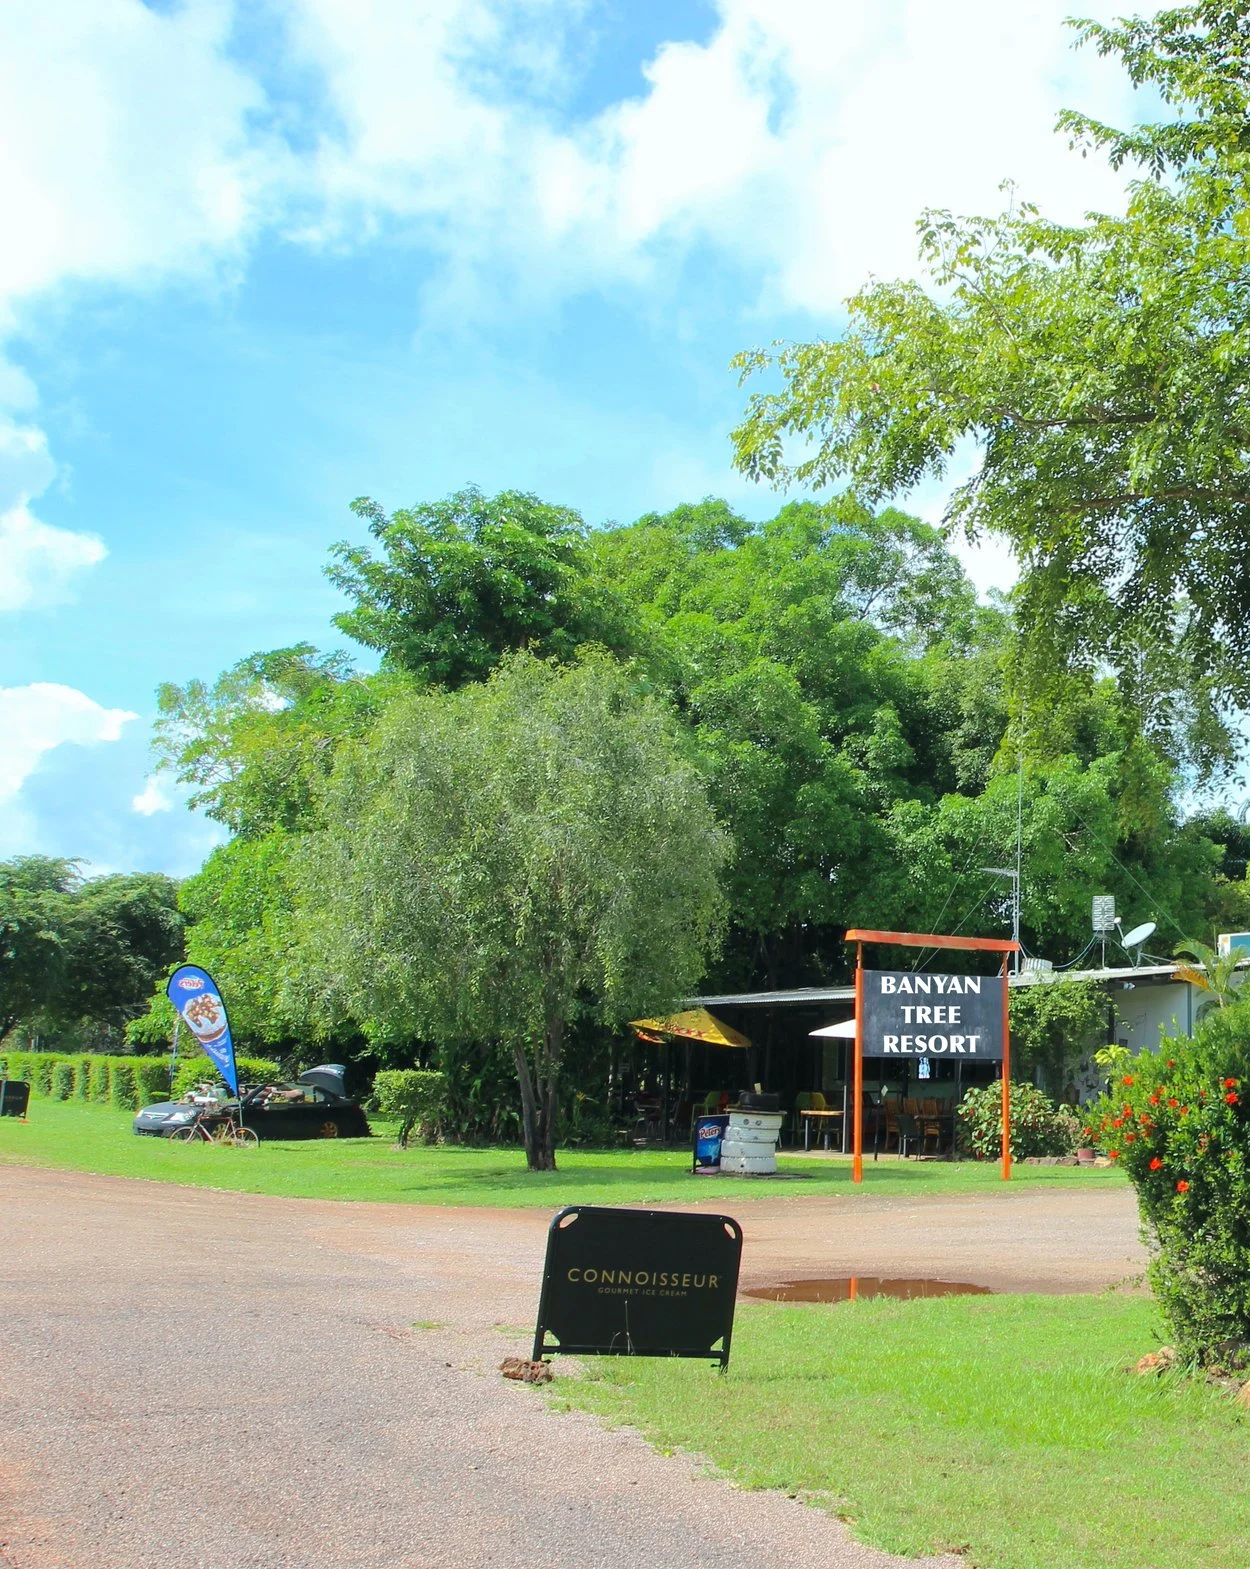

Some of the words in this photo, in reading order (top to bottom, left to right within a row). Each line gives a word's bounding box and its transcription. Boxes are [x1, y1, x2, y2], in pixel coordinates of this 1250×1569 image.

[881, 976, 981, 994] BANYAN
[901, 1005, 961, 1024] TREE
[883, 1035, 980, 1053] RESORT
[699, 1126, 720, 1139] Peters
[567, 1268, 719, 1289] CONNOISSEUR
[598, 1287, 639, 1295] GOURMET
